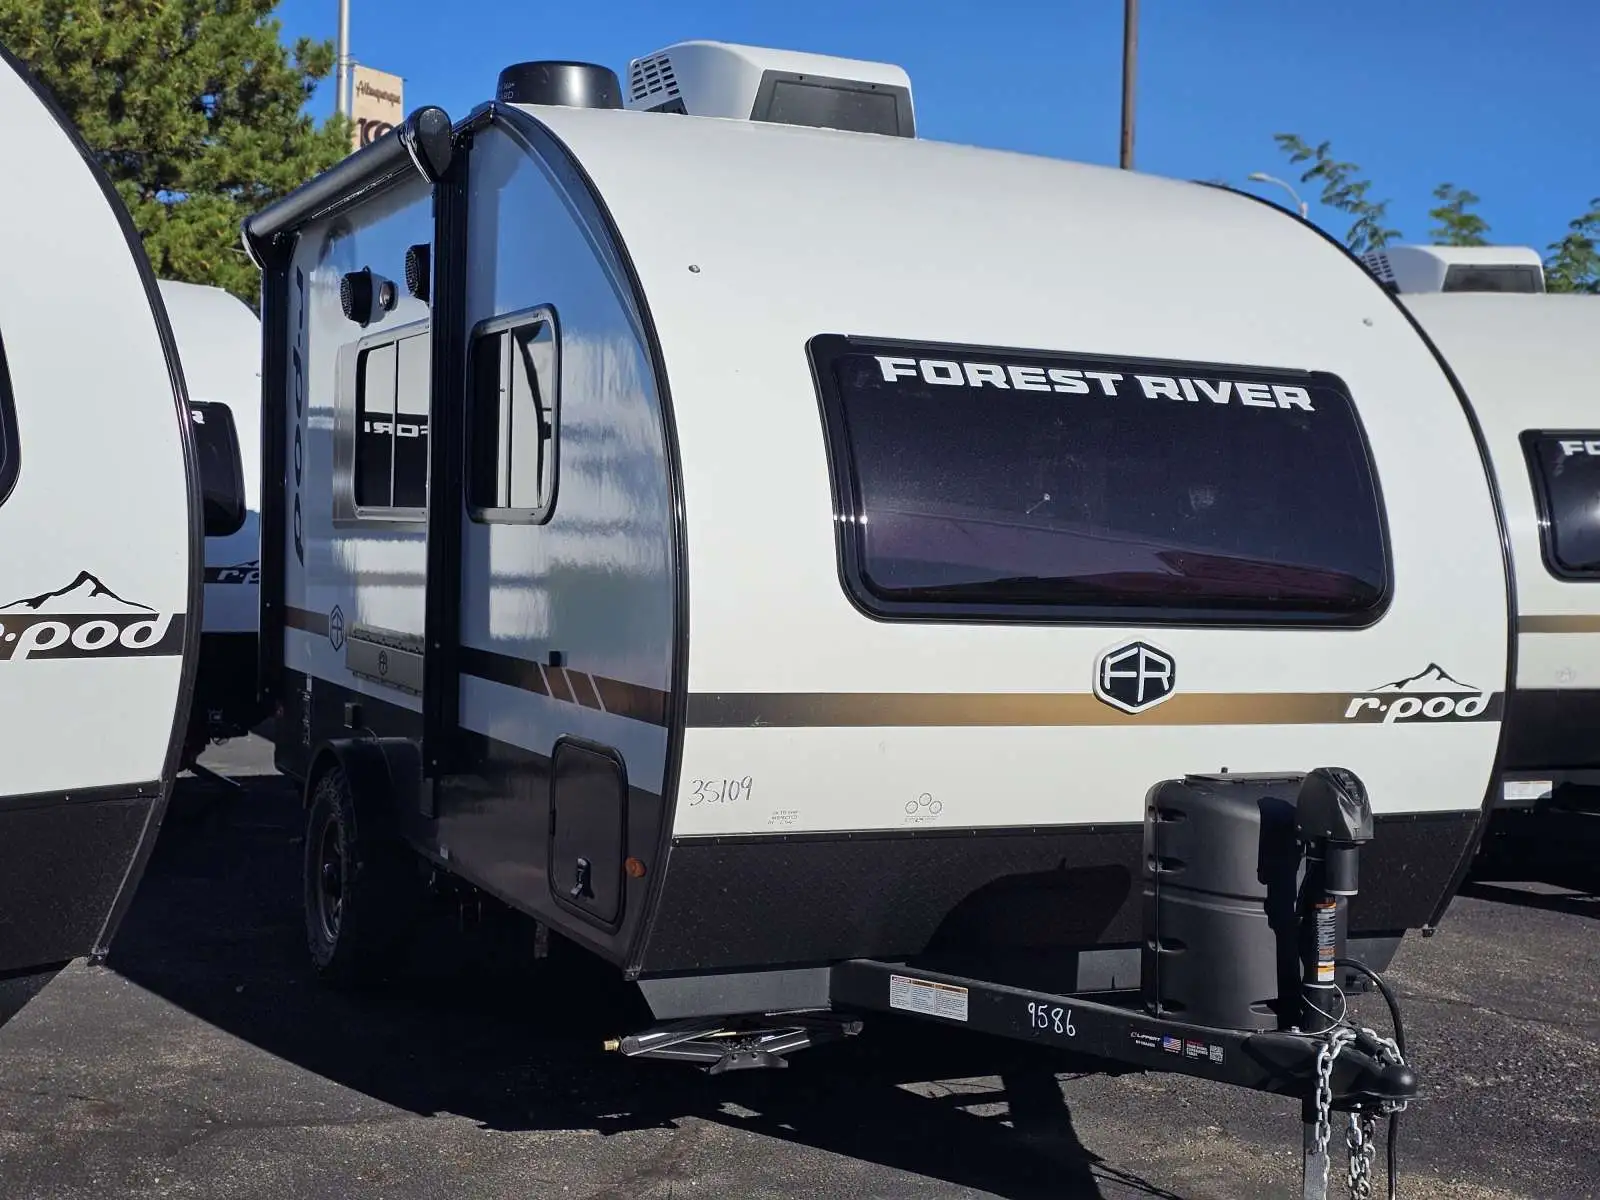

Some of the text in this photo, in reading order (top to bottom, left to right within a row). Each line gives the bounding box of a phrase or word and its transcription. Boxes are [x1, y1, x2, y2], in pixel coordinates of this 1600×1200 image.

[874, 356, 1315, 412] FOREST RIVER
[690, 775, 753, 806] 35109
[1028, 1002, 1076, 1037] 9586
